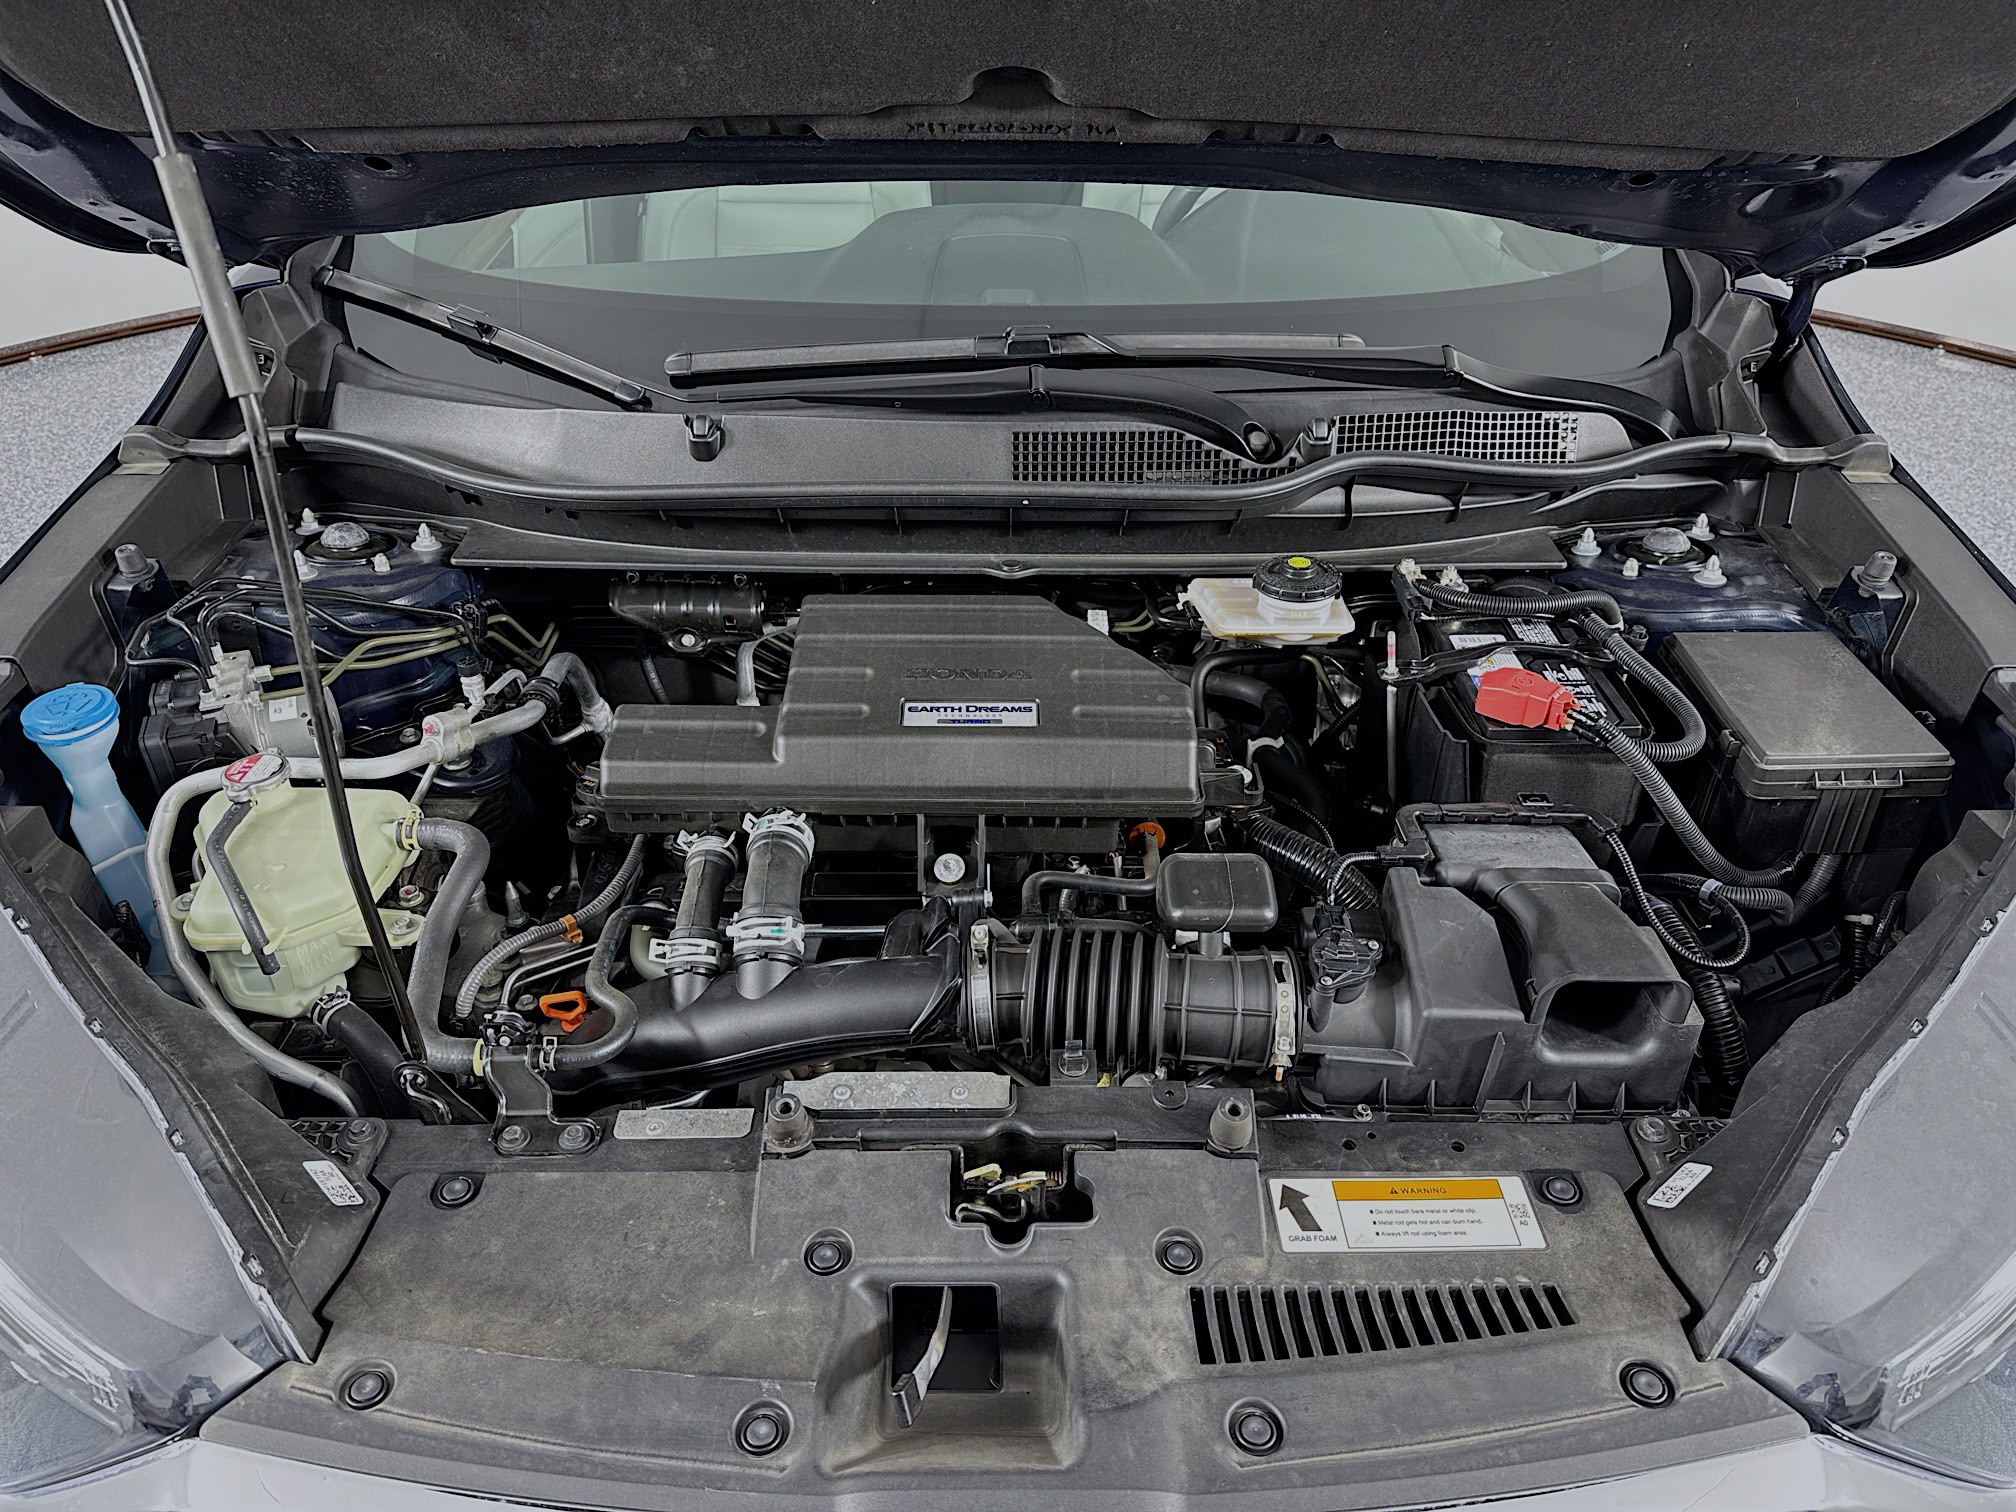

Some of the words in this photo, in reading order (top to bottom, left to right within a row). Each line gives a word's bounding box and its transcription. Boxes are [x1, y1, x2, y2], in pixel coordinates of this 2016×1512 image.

[902, 668, 1032, 680] HONDA
[966, 705, 1033, 713] DREAMS
[296, 937, 328, 958] MAX
[300, 951, 334, 974] MIN
